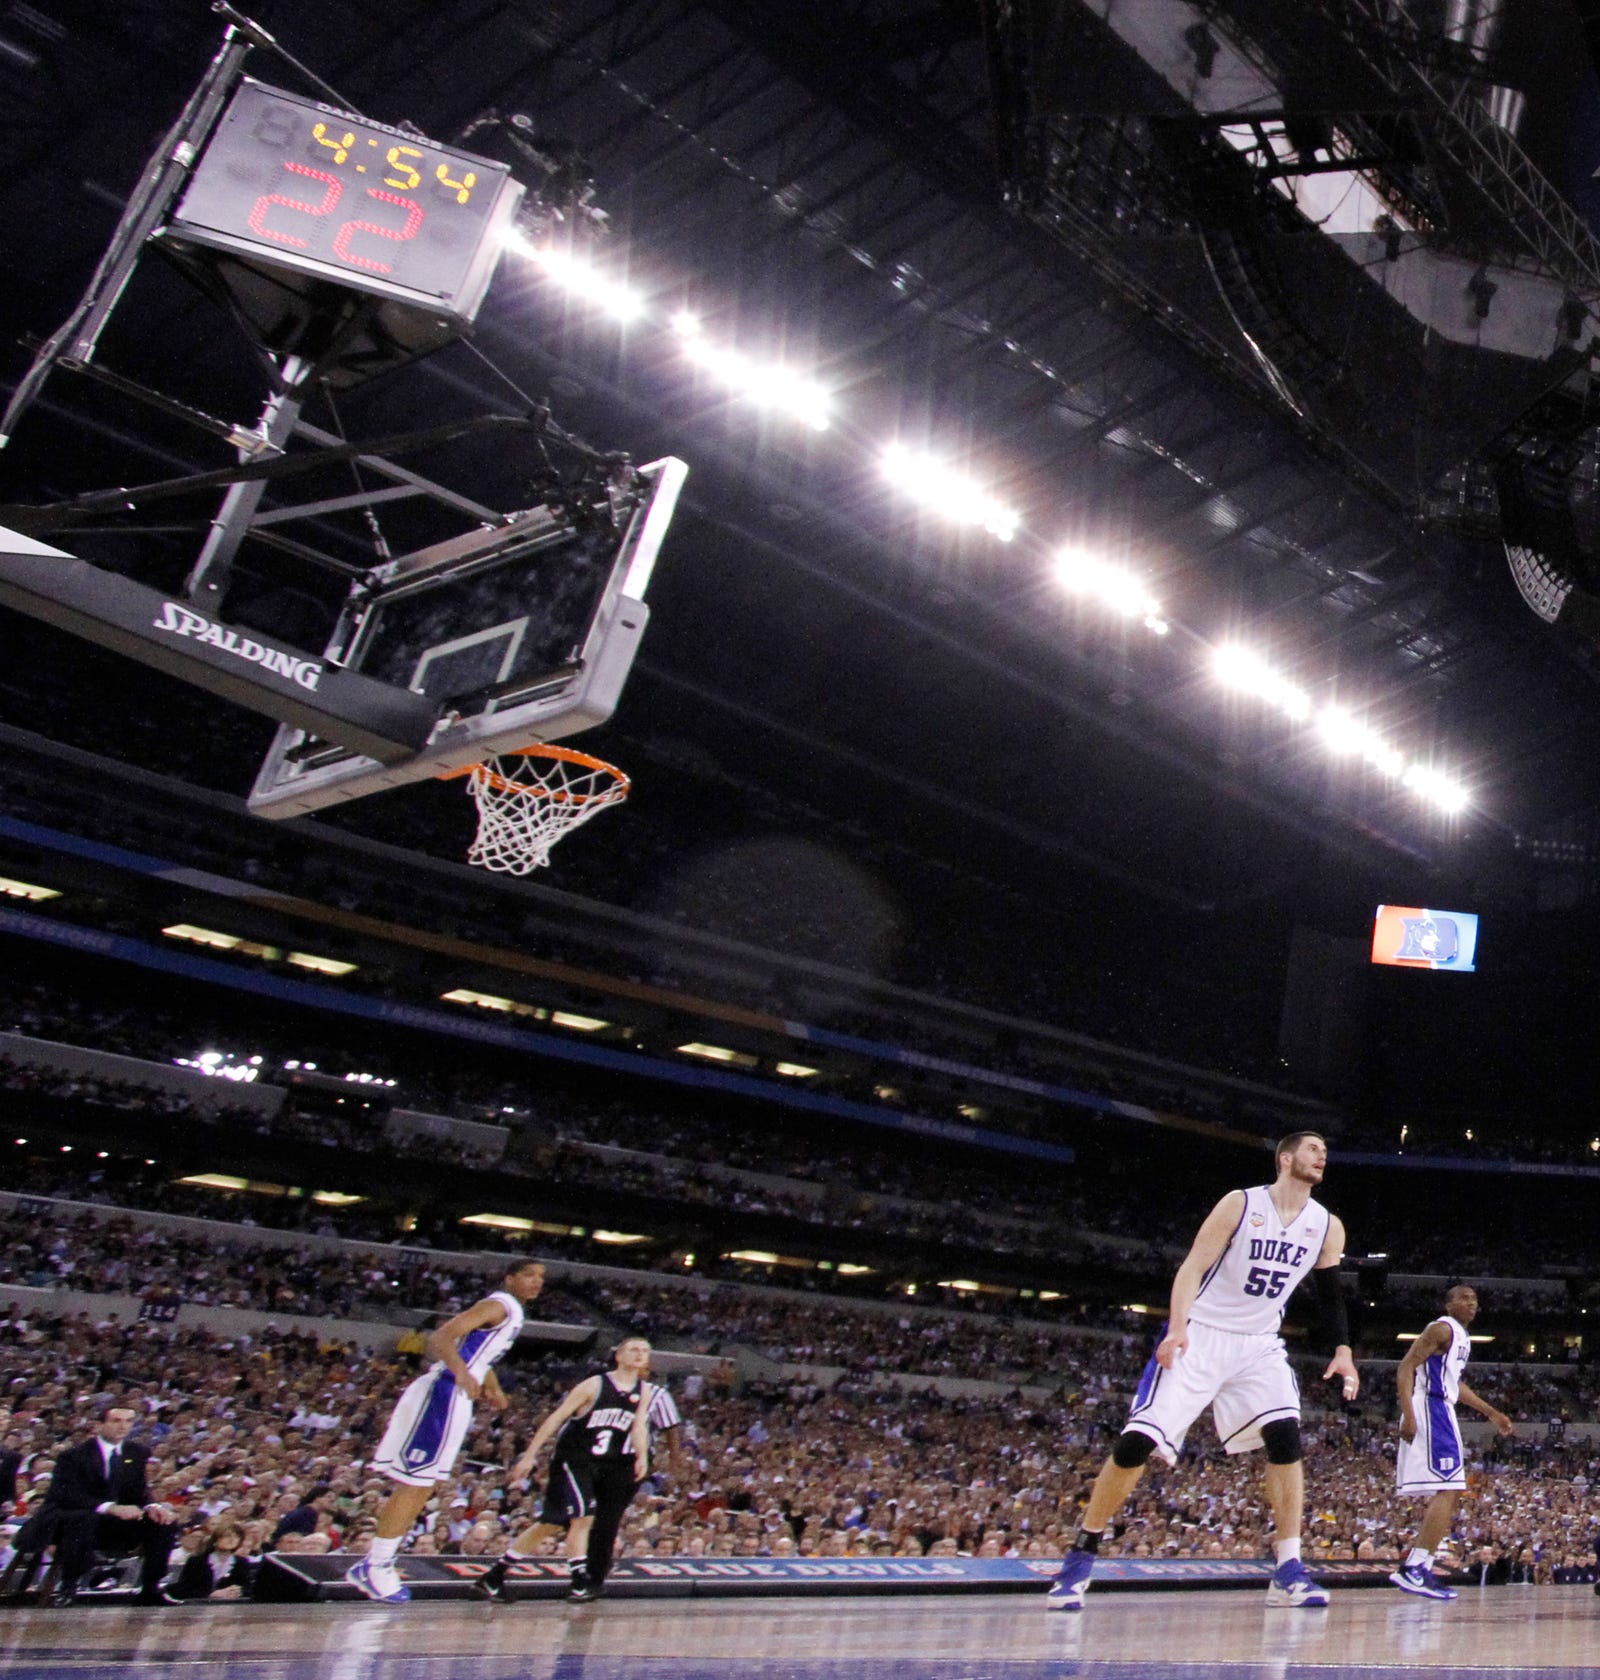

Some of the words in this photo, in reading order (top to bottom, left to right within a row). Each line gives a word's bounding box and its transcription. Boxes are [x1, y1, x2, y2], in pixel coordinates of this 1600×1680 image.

[317, 102, 443, 150] DAKTRONICS
[312, 122, 477, 206] 4:54
[247, 161, 426, 274] 22
[152, 602, 323, 692] SPALDING
[1248, 1238, 1308, 1267] DUKE
[1243, 1266, 1291, 1299] 55
[142, 1304, 176, 1318] 114
[591, 1429, 613, 1455] 3
[633, 1562, 789, 1577] BLUE
[787, 1562, 965, 1577] DEVILS
